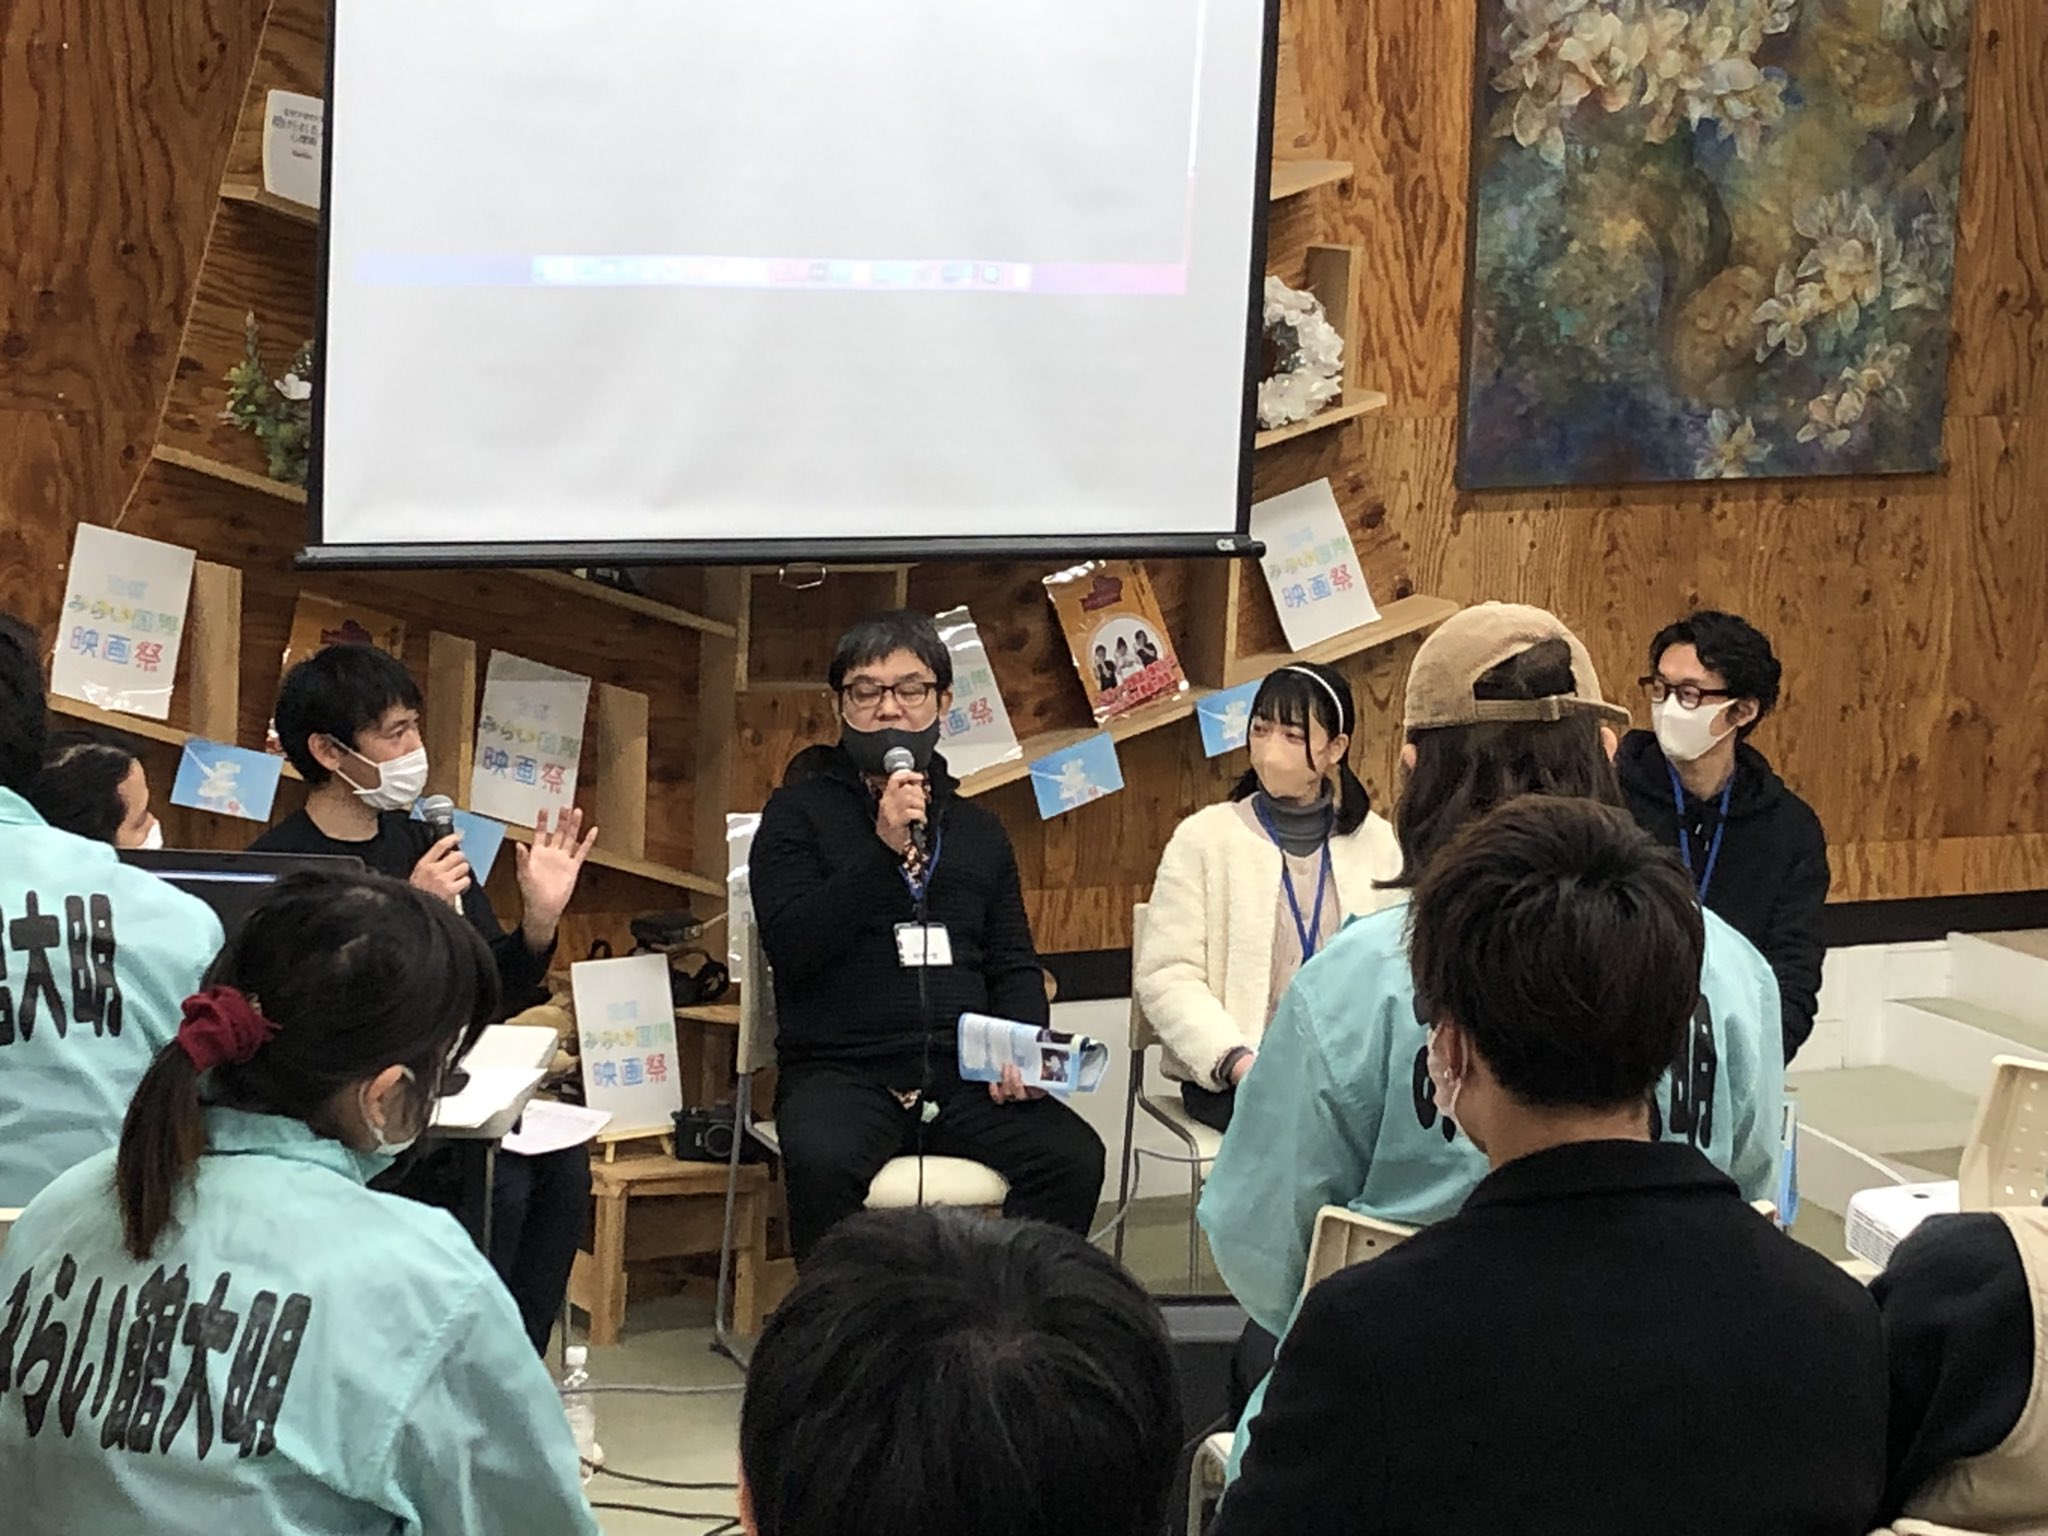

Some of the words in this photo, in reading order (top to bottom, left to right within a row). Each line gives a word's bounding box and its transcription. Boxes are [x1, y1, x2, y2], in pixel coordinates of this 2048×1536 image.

[1281, 563, 1353, 608] 映画祭
[70, 626, 163, 672] 映画祭
[942, 697, 994, 741] 画祭
[483, 746, 566, 794] 映画祭
[0, 889, 124, 1046] 大明
[593, 1053, 668, 1088] 映画祭
